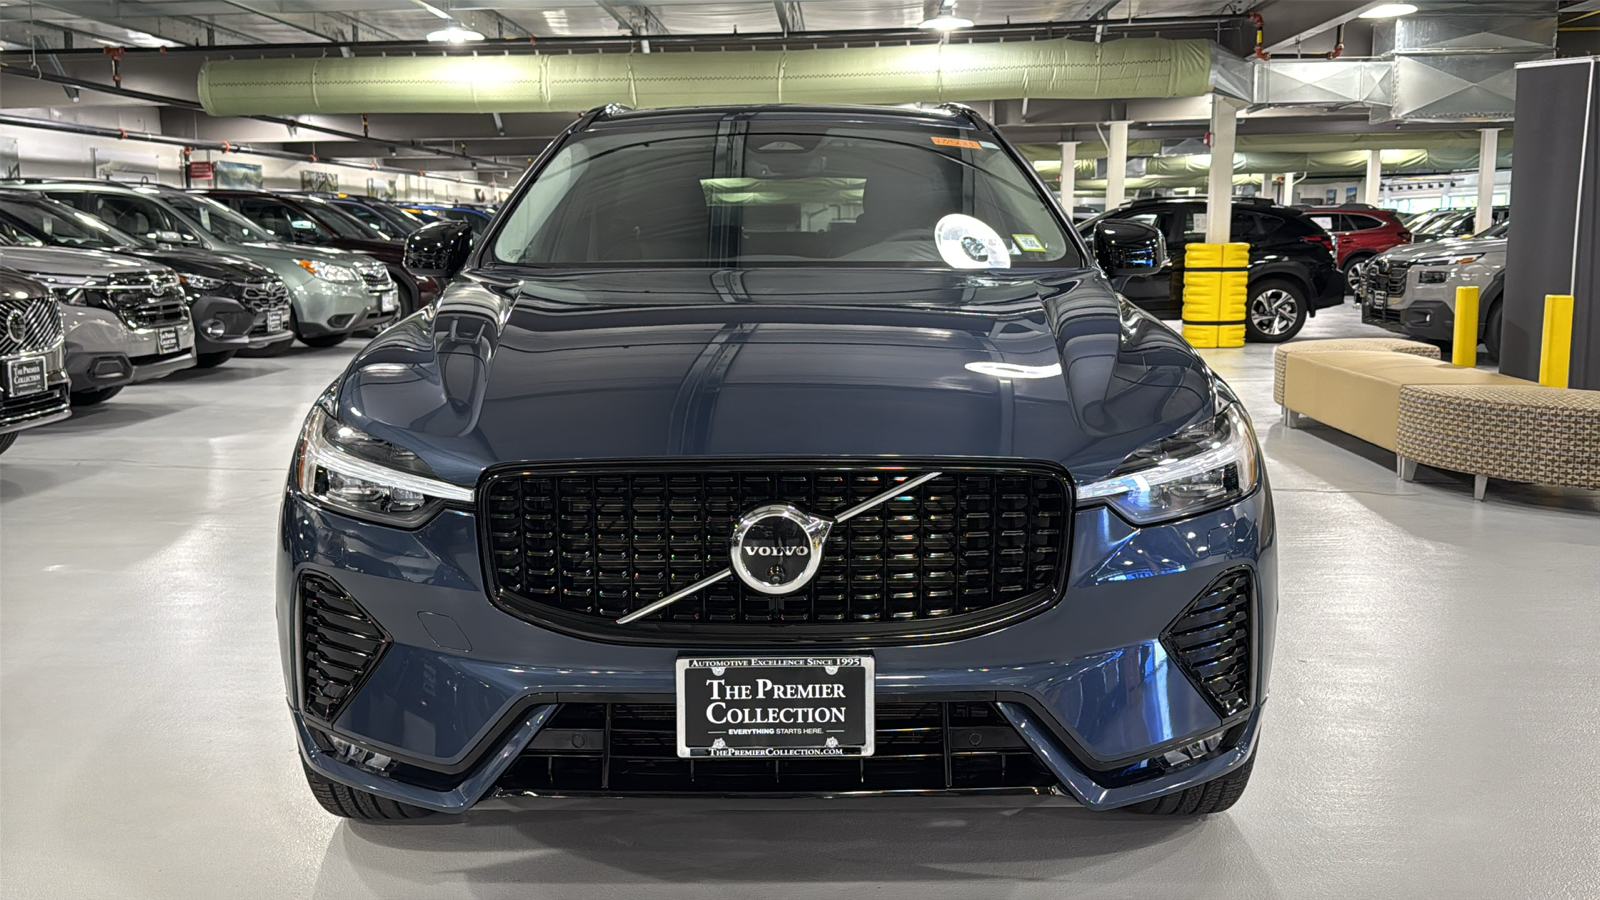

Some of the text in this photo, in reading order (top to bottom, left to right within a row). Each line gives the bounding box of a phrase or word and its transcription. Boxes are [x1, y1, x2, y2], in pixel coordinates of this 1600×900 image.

[743, 546, 809, 556] VOLVO
[691, 659, 749, 667] AUTOMOTIVE
[751, 658, 804, 666] EXCELLENCE
[836, 658, 860, 666] 1995
[706, 678, 846, 700] THE PREMIER
[706, 702, 846, 724] COLLECTION
